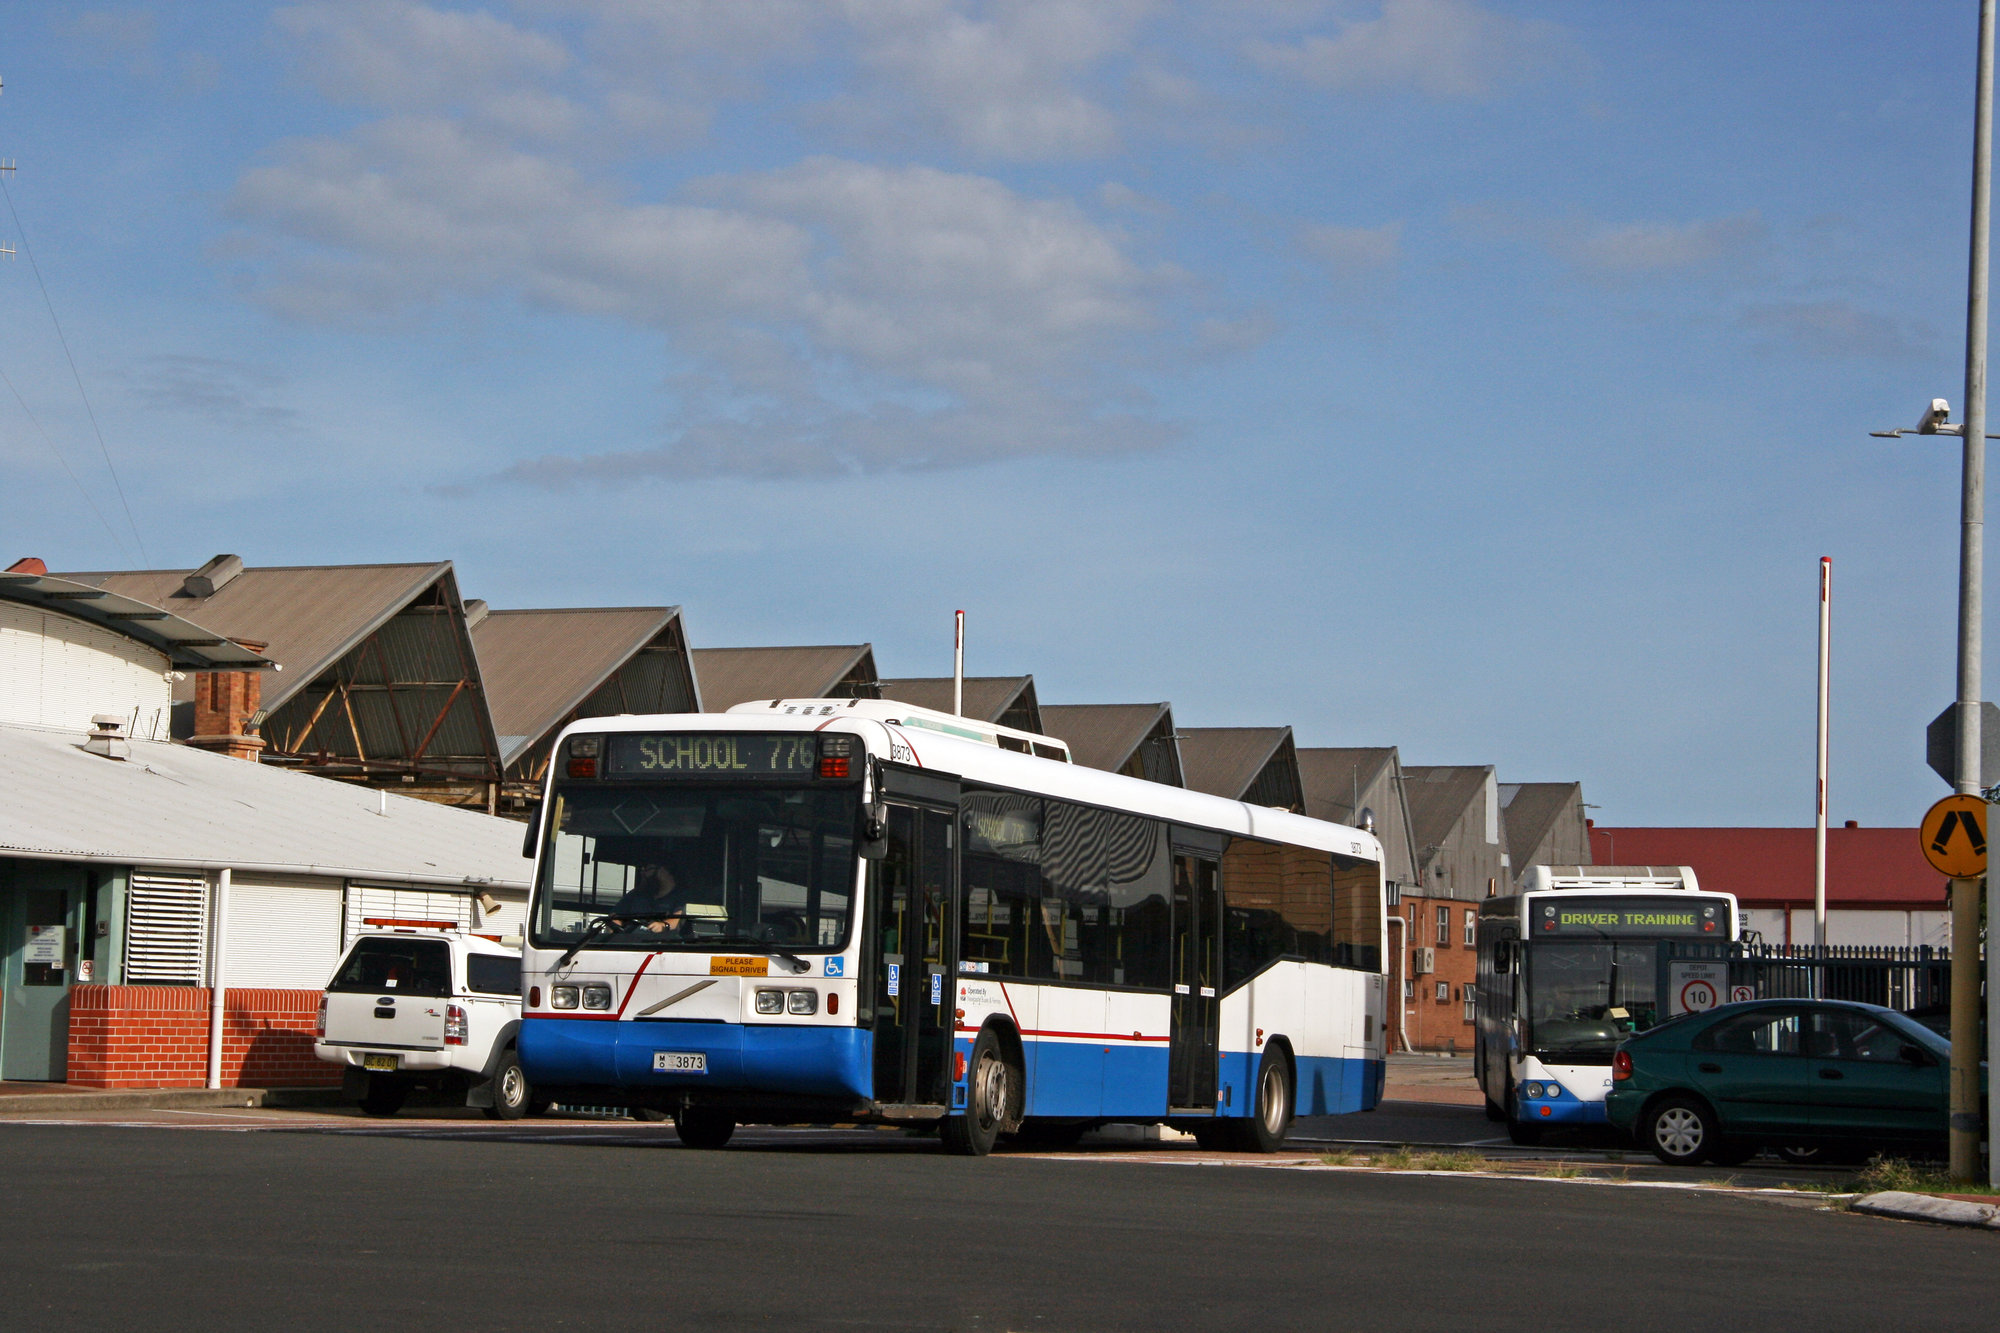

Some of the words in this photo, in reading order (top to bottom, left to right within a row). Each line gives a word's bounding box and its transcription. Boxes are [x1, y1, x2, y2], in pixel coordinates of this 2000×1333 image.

[639, 736, 748, 769] SCHOOL
[766, 736, 815, 770] 776
[893, 744, 911, 762] 3873
[1561, 913, 1619, 925] DRIVER
[1624, 914, 1697, 925] TRAINING
[711, 965, 738, 973] SIGNAL
[740, 966, 767, 974] DRIVER
[1690, 991, 1706, 1004] 10
[676, 1056, 703, 1069] 3873
